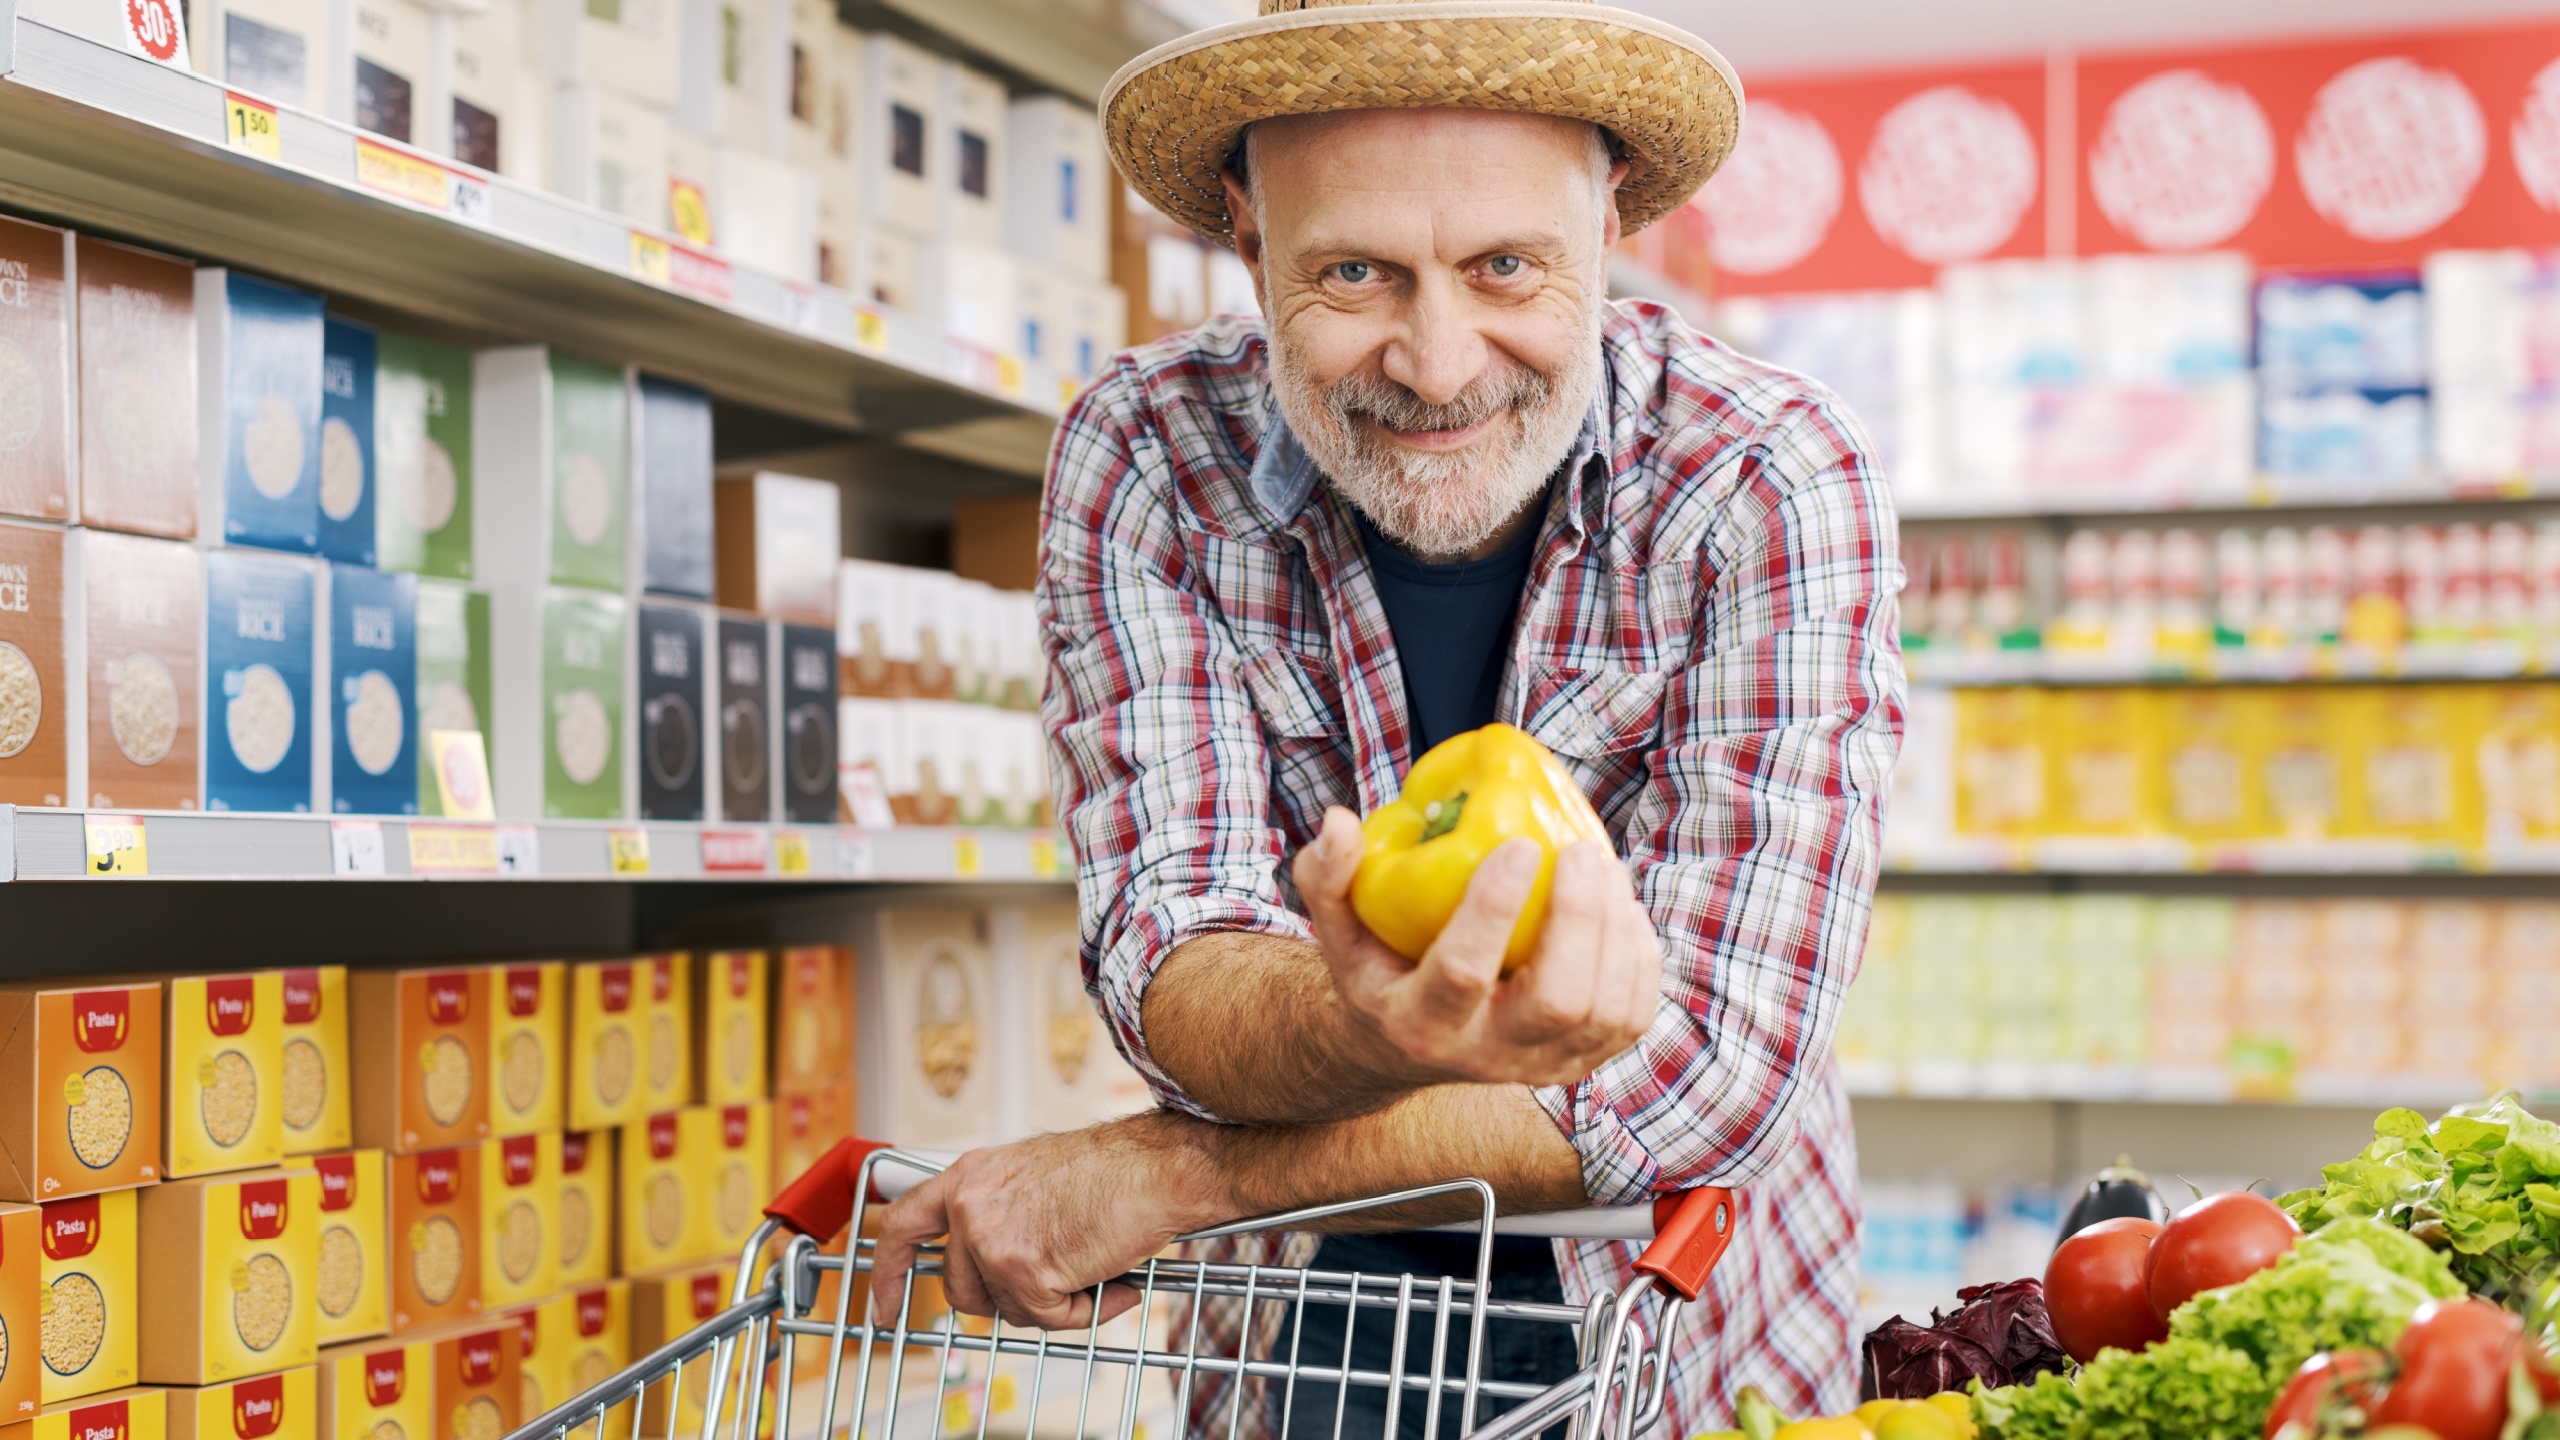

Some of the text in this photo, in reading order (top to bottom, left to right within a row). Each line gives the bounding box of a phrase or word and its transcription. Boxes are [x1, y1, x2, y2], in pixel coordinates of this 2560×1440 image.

[0, 257, 29, 281] WN
[218, 997, 244, 1014] Pasta
[88, 1011, 116, 1028] Pasta
[251, 1201, 278, 1218] Pasta
[56, 1219, 86, 1236] Pasta
[245, 1399, 273, 1417] Pasta
[85, 1426, 115, 1440] Pasta
